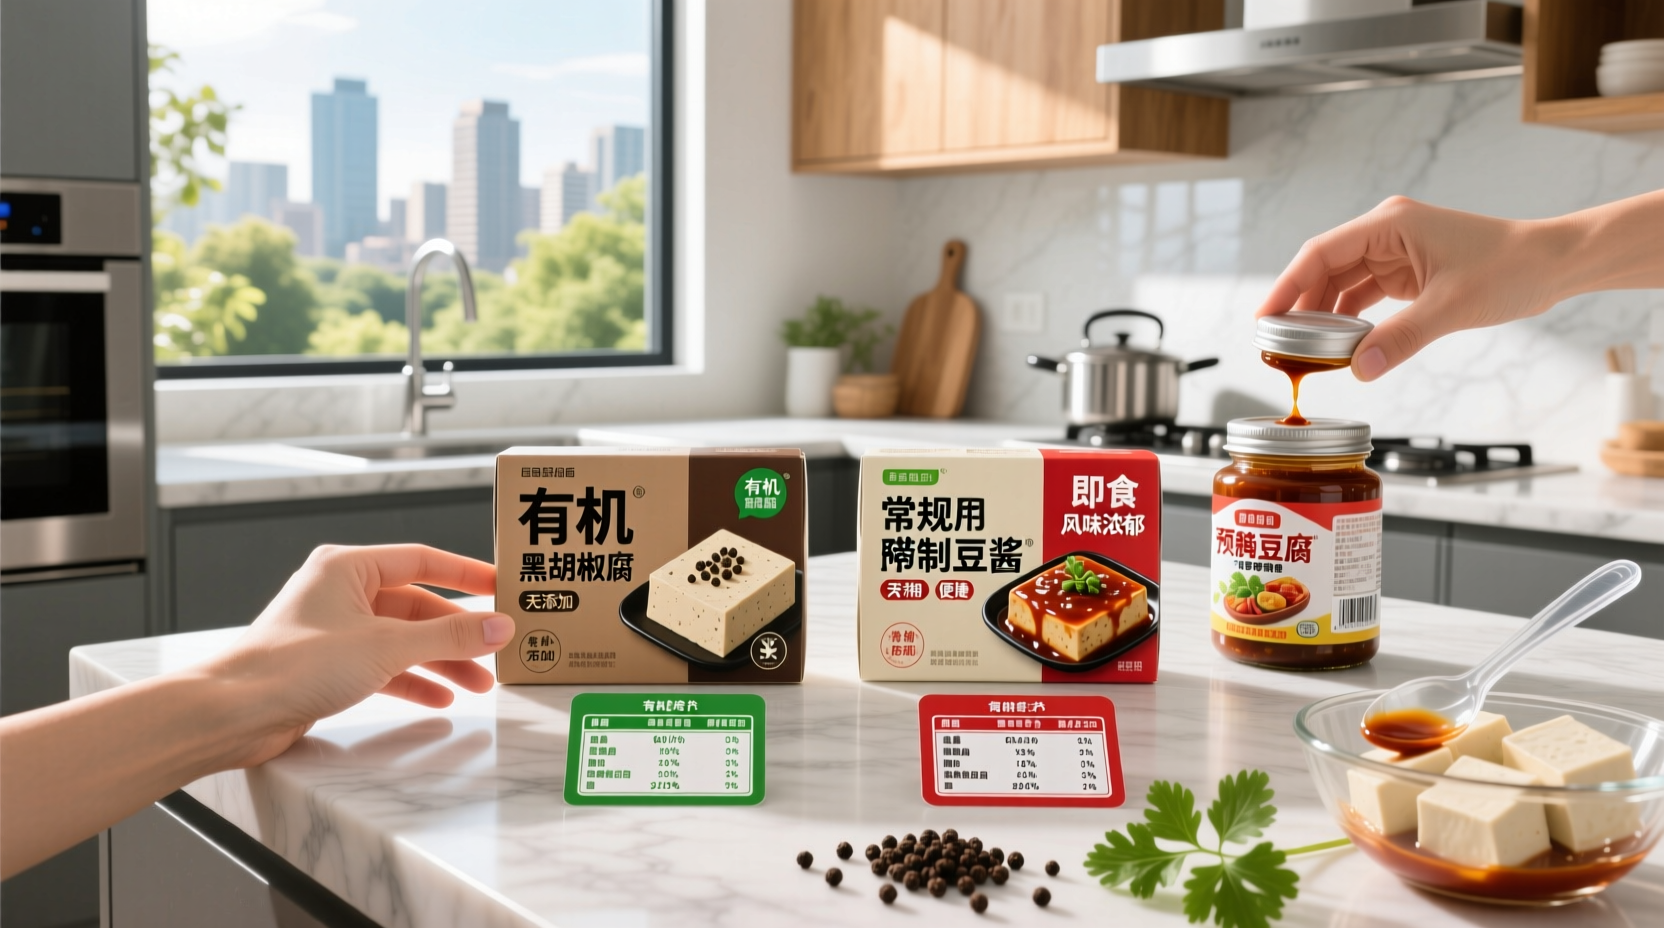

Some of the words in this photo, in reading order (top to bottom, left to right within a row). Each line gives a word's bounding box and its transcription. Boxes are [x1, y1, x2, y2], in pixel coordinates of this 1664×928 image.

[744, 477, 781, 497] 有机
[1071, 473, 1139, 509] 即食
[518, 486, 634, 546] 有机
[881, 495, 985, 532] 常规用
[1061, 513, 1146, 537] 风味浓郁
